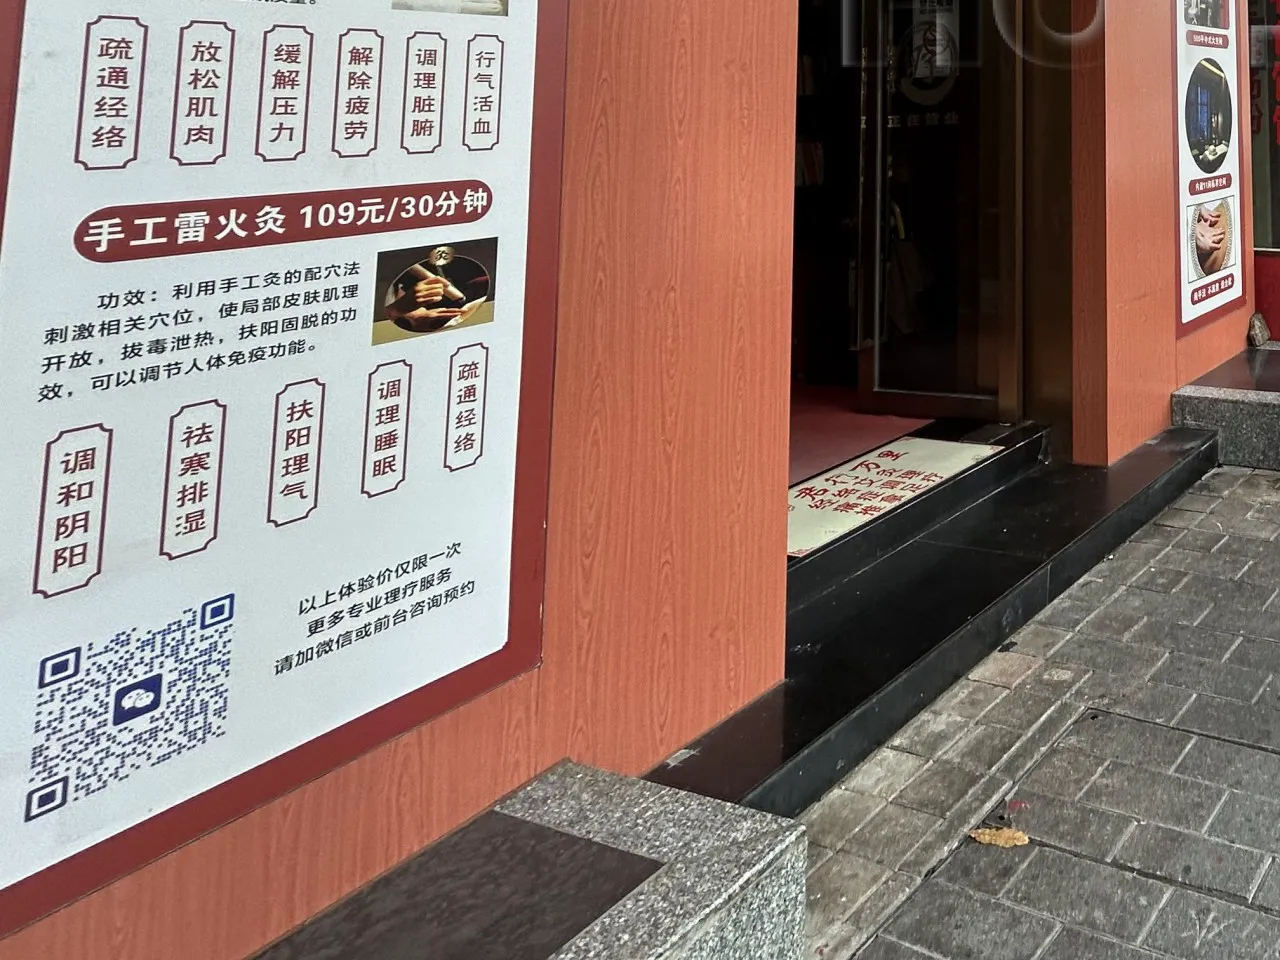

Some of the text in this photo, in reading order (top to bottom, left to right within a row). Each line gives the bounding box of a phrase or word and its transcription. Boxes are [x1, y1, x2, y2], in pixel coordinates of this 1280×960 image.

[92, 37, 135, 149] 疏通经络
[183, 41, 222, 146] 放松肌肉
[270, 43, 301, 143] 缓解压力
[343, 46, 373, 140] 解除疲劳
[409, 48, 437, 138] 调理脏腑
[471, 50, 495, 135] 行气活血
[84, 188, 487, 252] 手工雷火灸 109元/30分钟
[280, 400, 313, 501] 扶阳理气
[372, 379, 401, 476] 调理睡眠
[454, 360, 479, 454] 疏通经络
[53, 448, 96, 573] 调和阴阳
[175, 423, 212, 537] 祛寒排湿
[300, 542, 462, 615] 以上体验价仅限一次
[307, 568, 453, 638] 更多专业理疗服务
[274, 580, 475, 676] 请加微信或前台咨询预约
